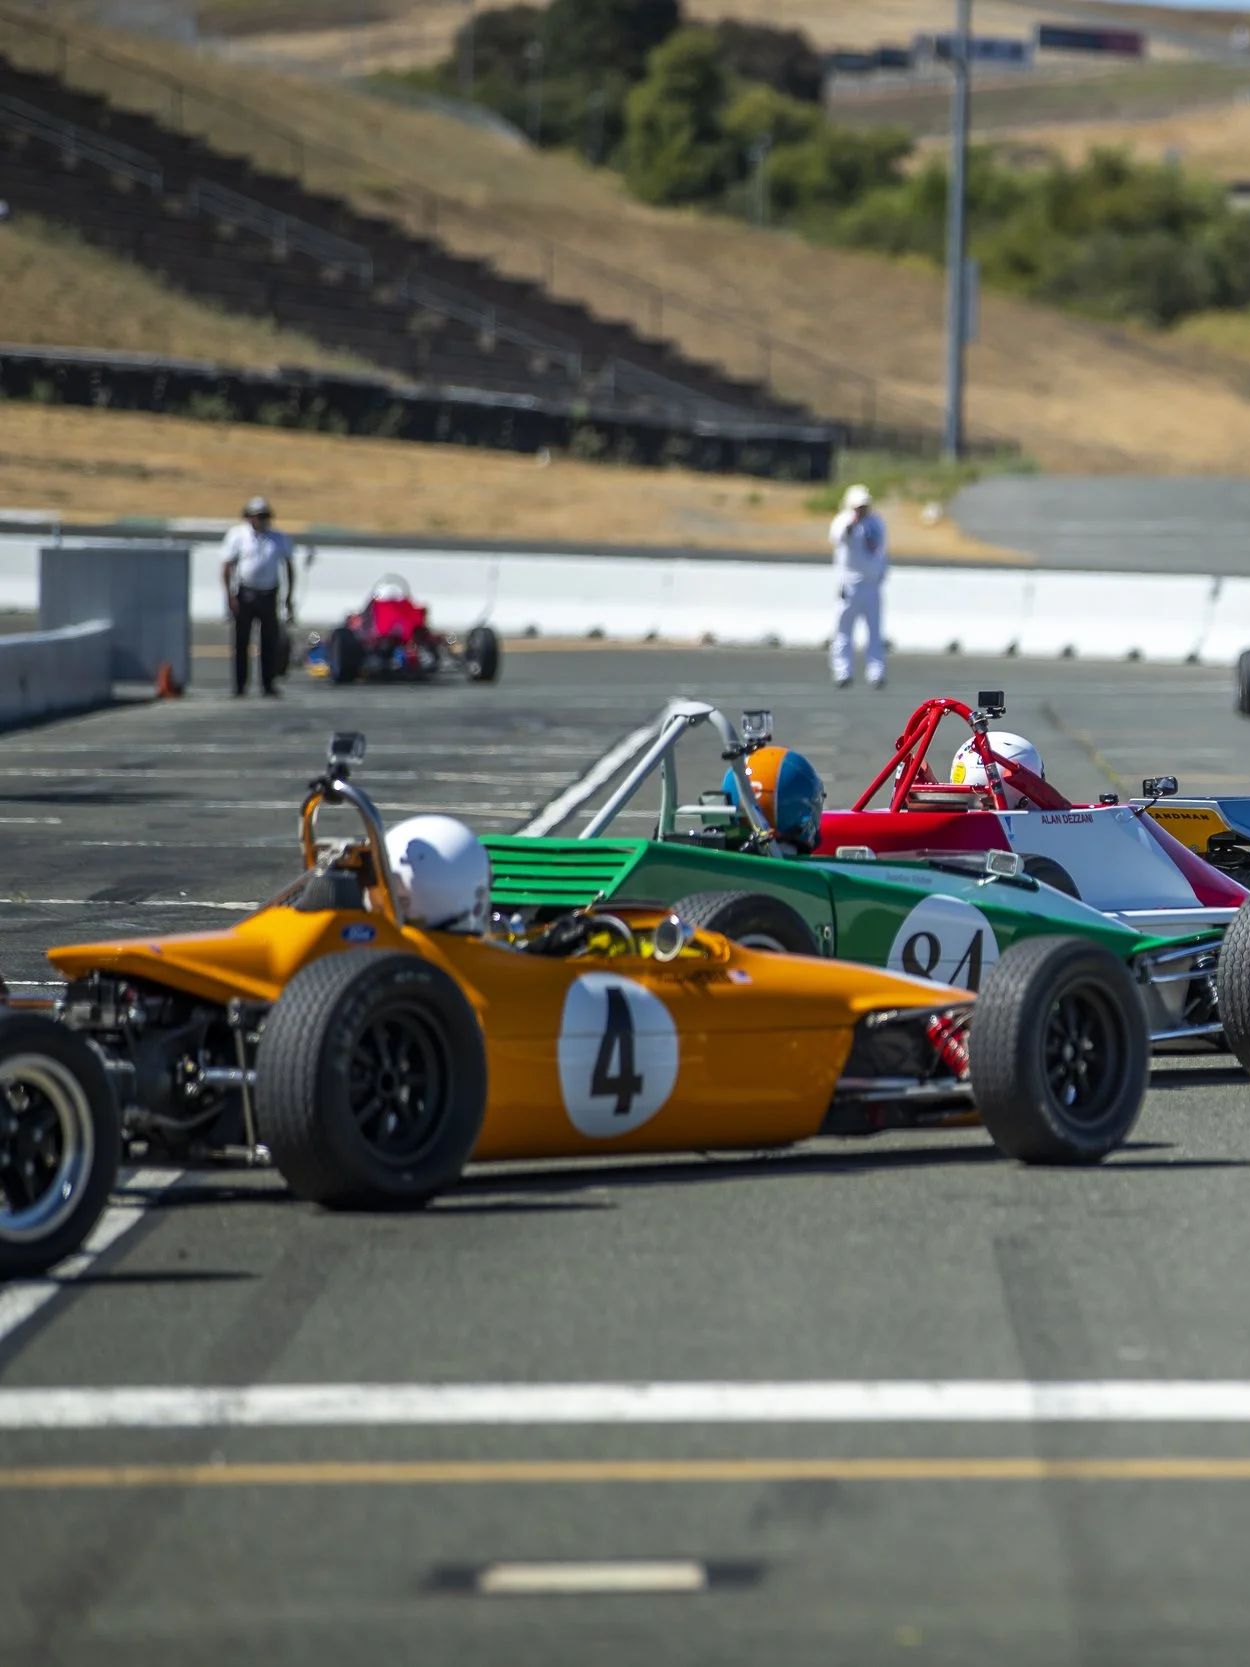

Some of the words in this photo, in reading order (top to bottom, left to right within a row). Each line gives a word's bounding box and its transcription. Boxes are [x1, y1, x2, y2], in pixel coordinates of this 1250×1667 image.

[1042, 814, 1062, 825] ALAN
[1063, 813, 1094, 824] DEZZANI
[902, 928, 984, 993] 84
[590, 986, 645, 1116] 4
